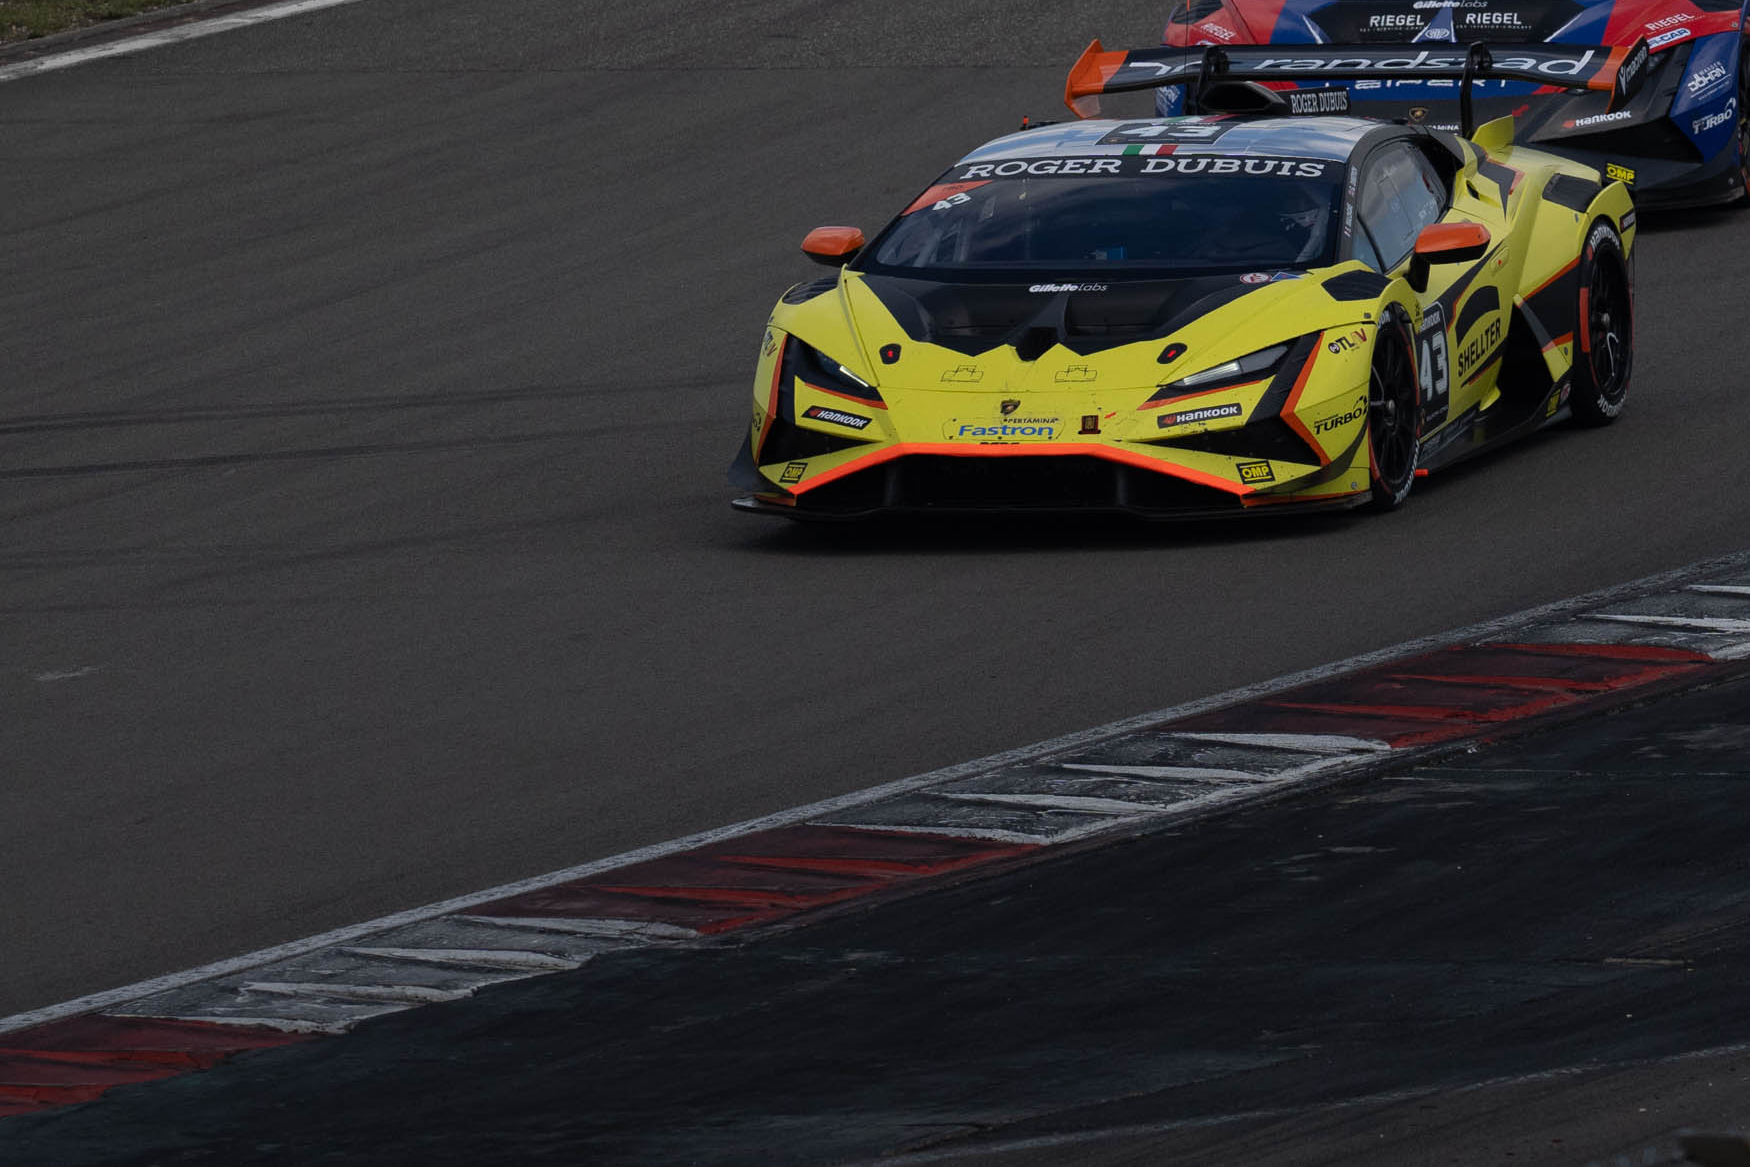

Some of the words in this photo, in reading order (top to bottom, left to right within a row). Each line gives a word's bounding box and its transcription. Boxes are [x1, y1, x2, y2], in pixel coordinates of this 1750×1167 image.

[1369, 14, 1425, 28] RIEGEL
[1465, 12, 1522, 25] RIEGEL
[1644, 12, 1695, 32] RIEGEL
[1252, 49, 1596, 75] randsad
[1290, 93, 1319, 114] ROGER
[1319, 90, 1348, 112] DUBUIS
[1119, 125, 1222, 137] 43
[959, 158, 1122, 180] ROGER
[1139, 158, 1326, 178] DUBUIS
[1607, 165, 1634, 182] OMP
[932, 192, 972, 211] 43
[1458, 318, 1501, 378] SHELLTER
[1419, 331, 1448, 402] 43
[958, 424, 1055, 437] Fastron
[1314, 408, 1363, 435] TURBO
[1241, 465, 1271, 479] OMP
